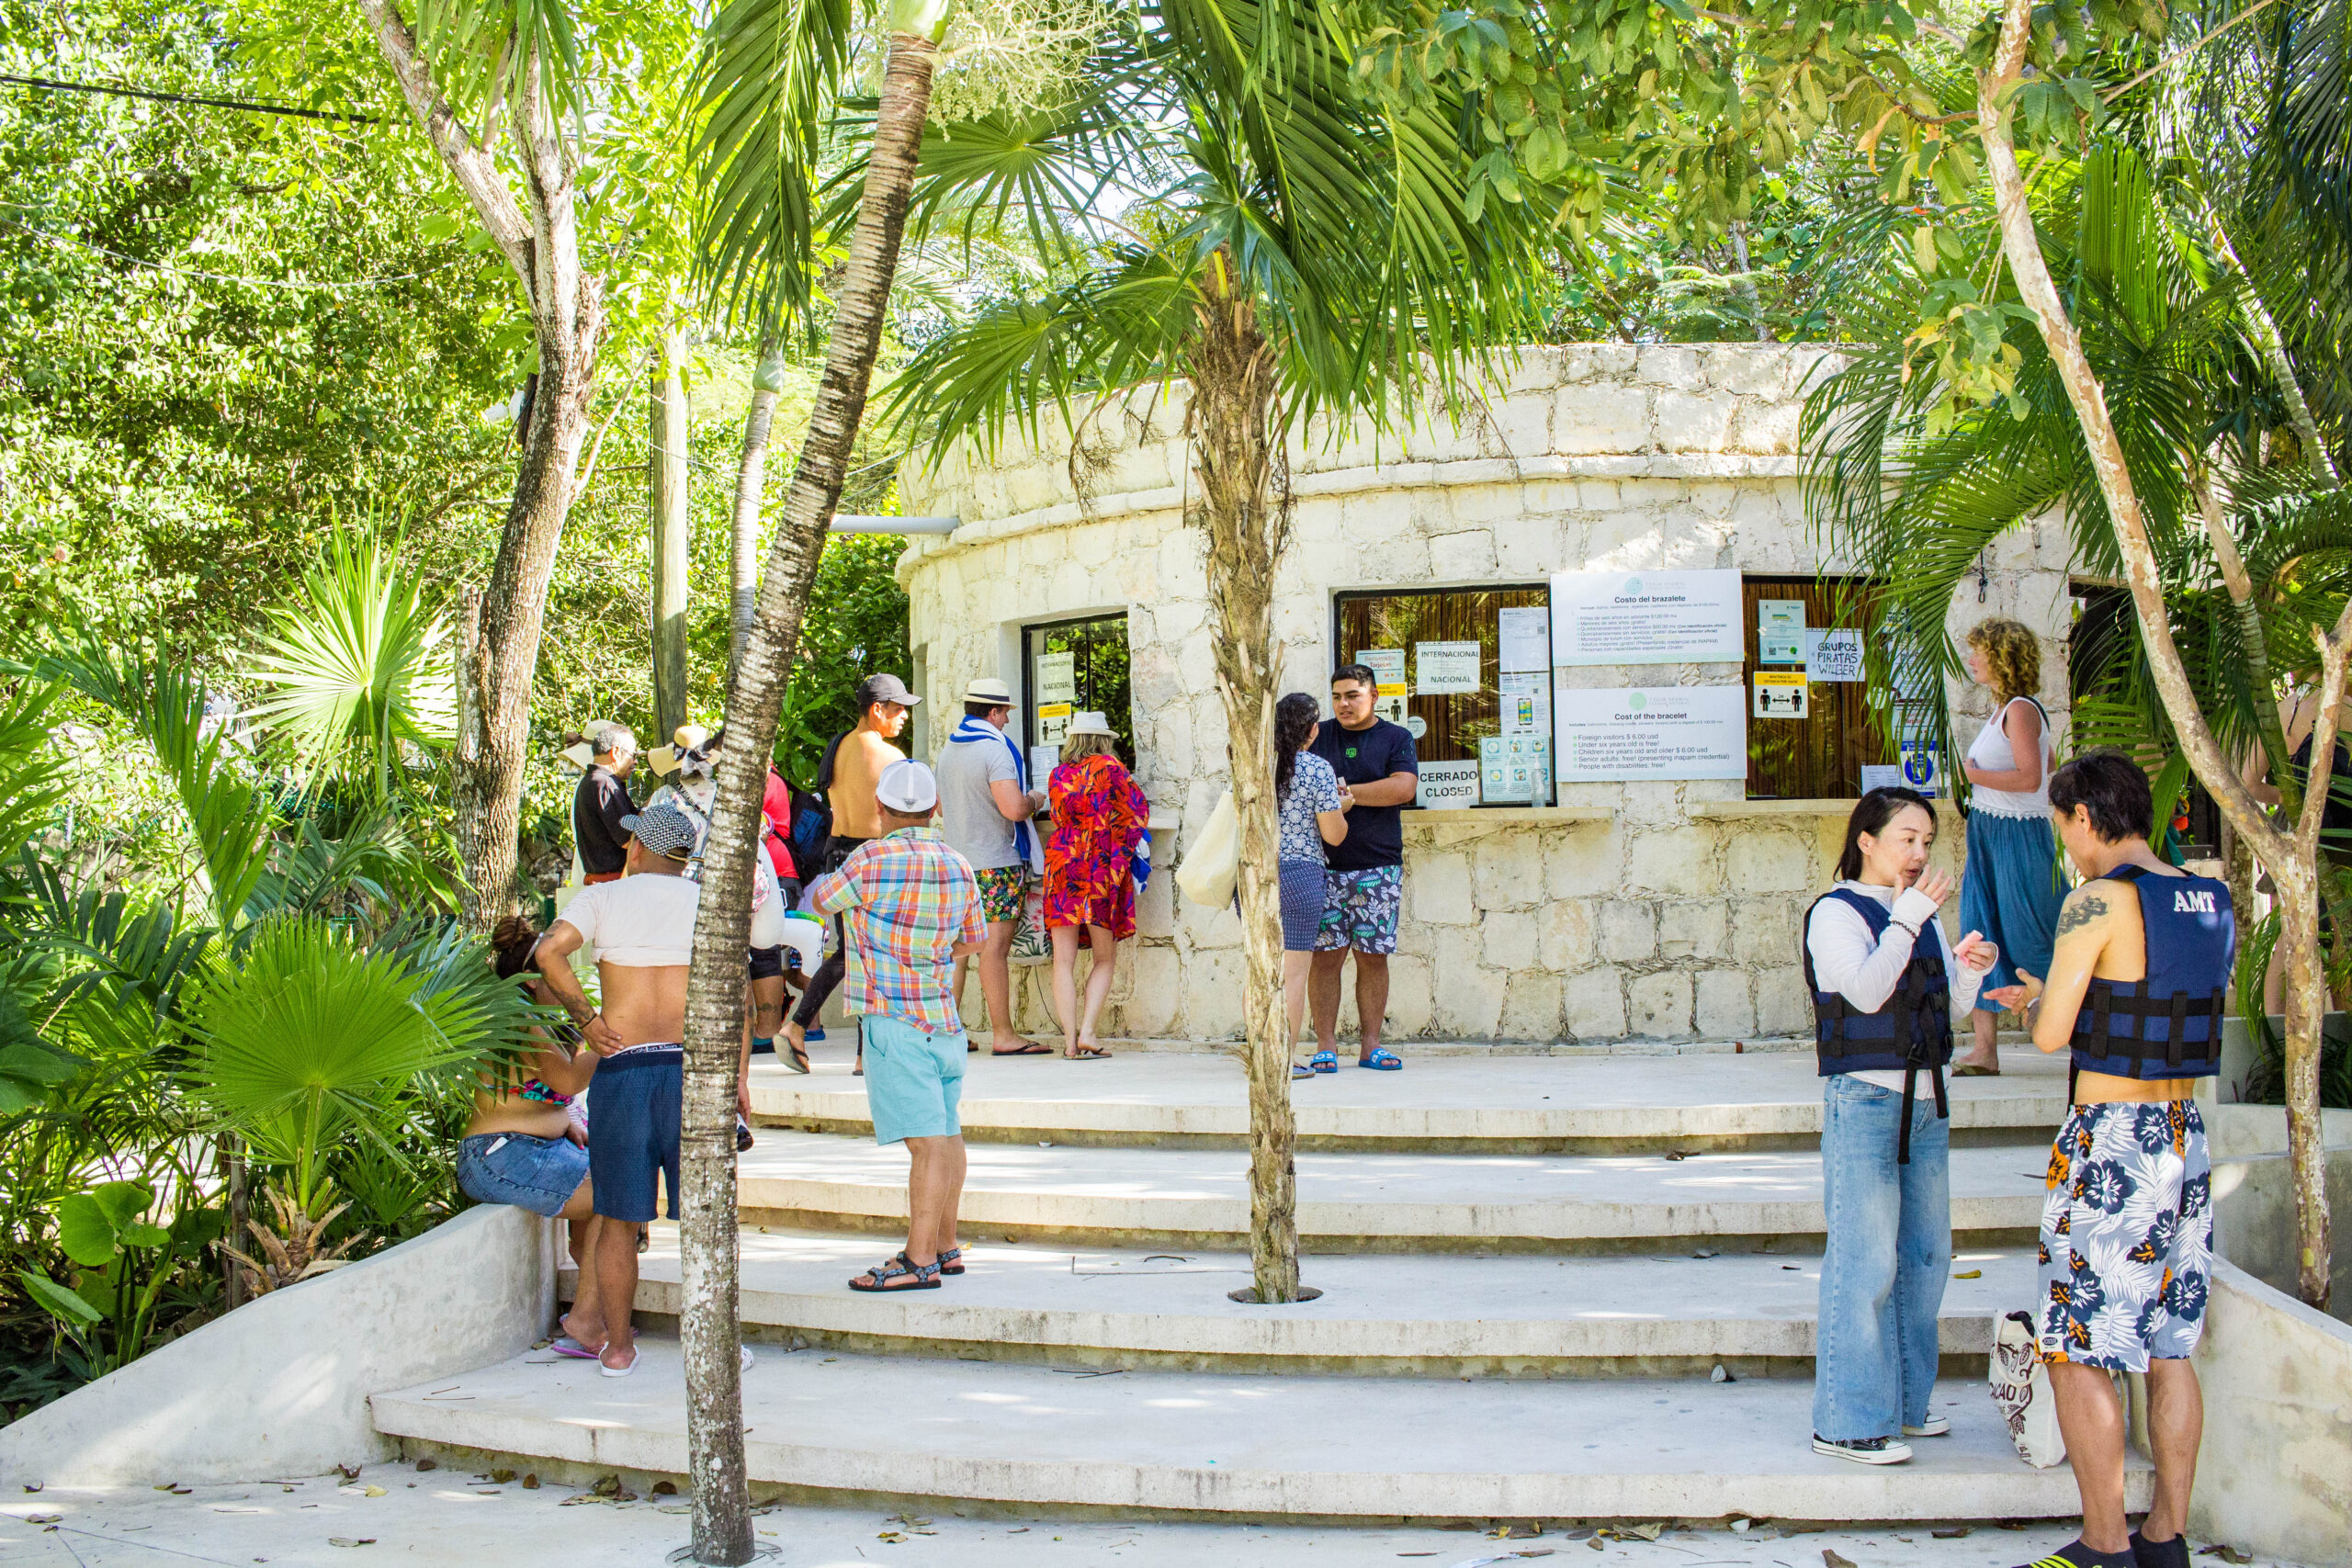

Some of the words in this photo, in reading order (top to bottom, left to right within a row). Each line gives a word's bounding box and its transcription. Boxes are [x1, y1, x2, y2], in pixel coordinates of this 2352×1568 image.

[1817, 642, 1857, 652] GRUPOS
[1817, 652, 1858, 664] PIRATAS
[1818, 664, 1856, 676] WILBER
[1043, 682, 1072, 691] NACIONAL
[1420, 770, 1478, 782] CERRADO
[1425, 786, 1473, 798] CLOSED
[2174, 890, 2216, 913] AMT
[630, 1046, 658, 1054] Calvin
